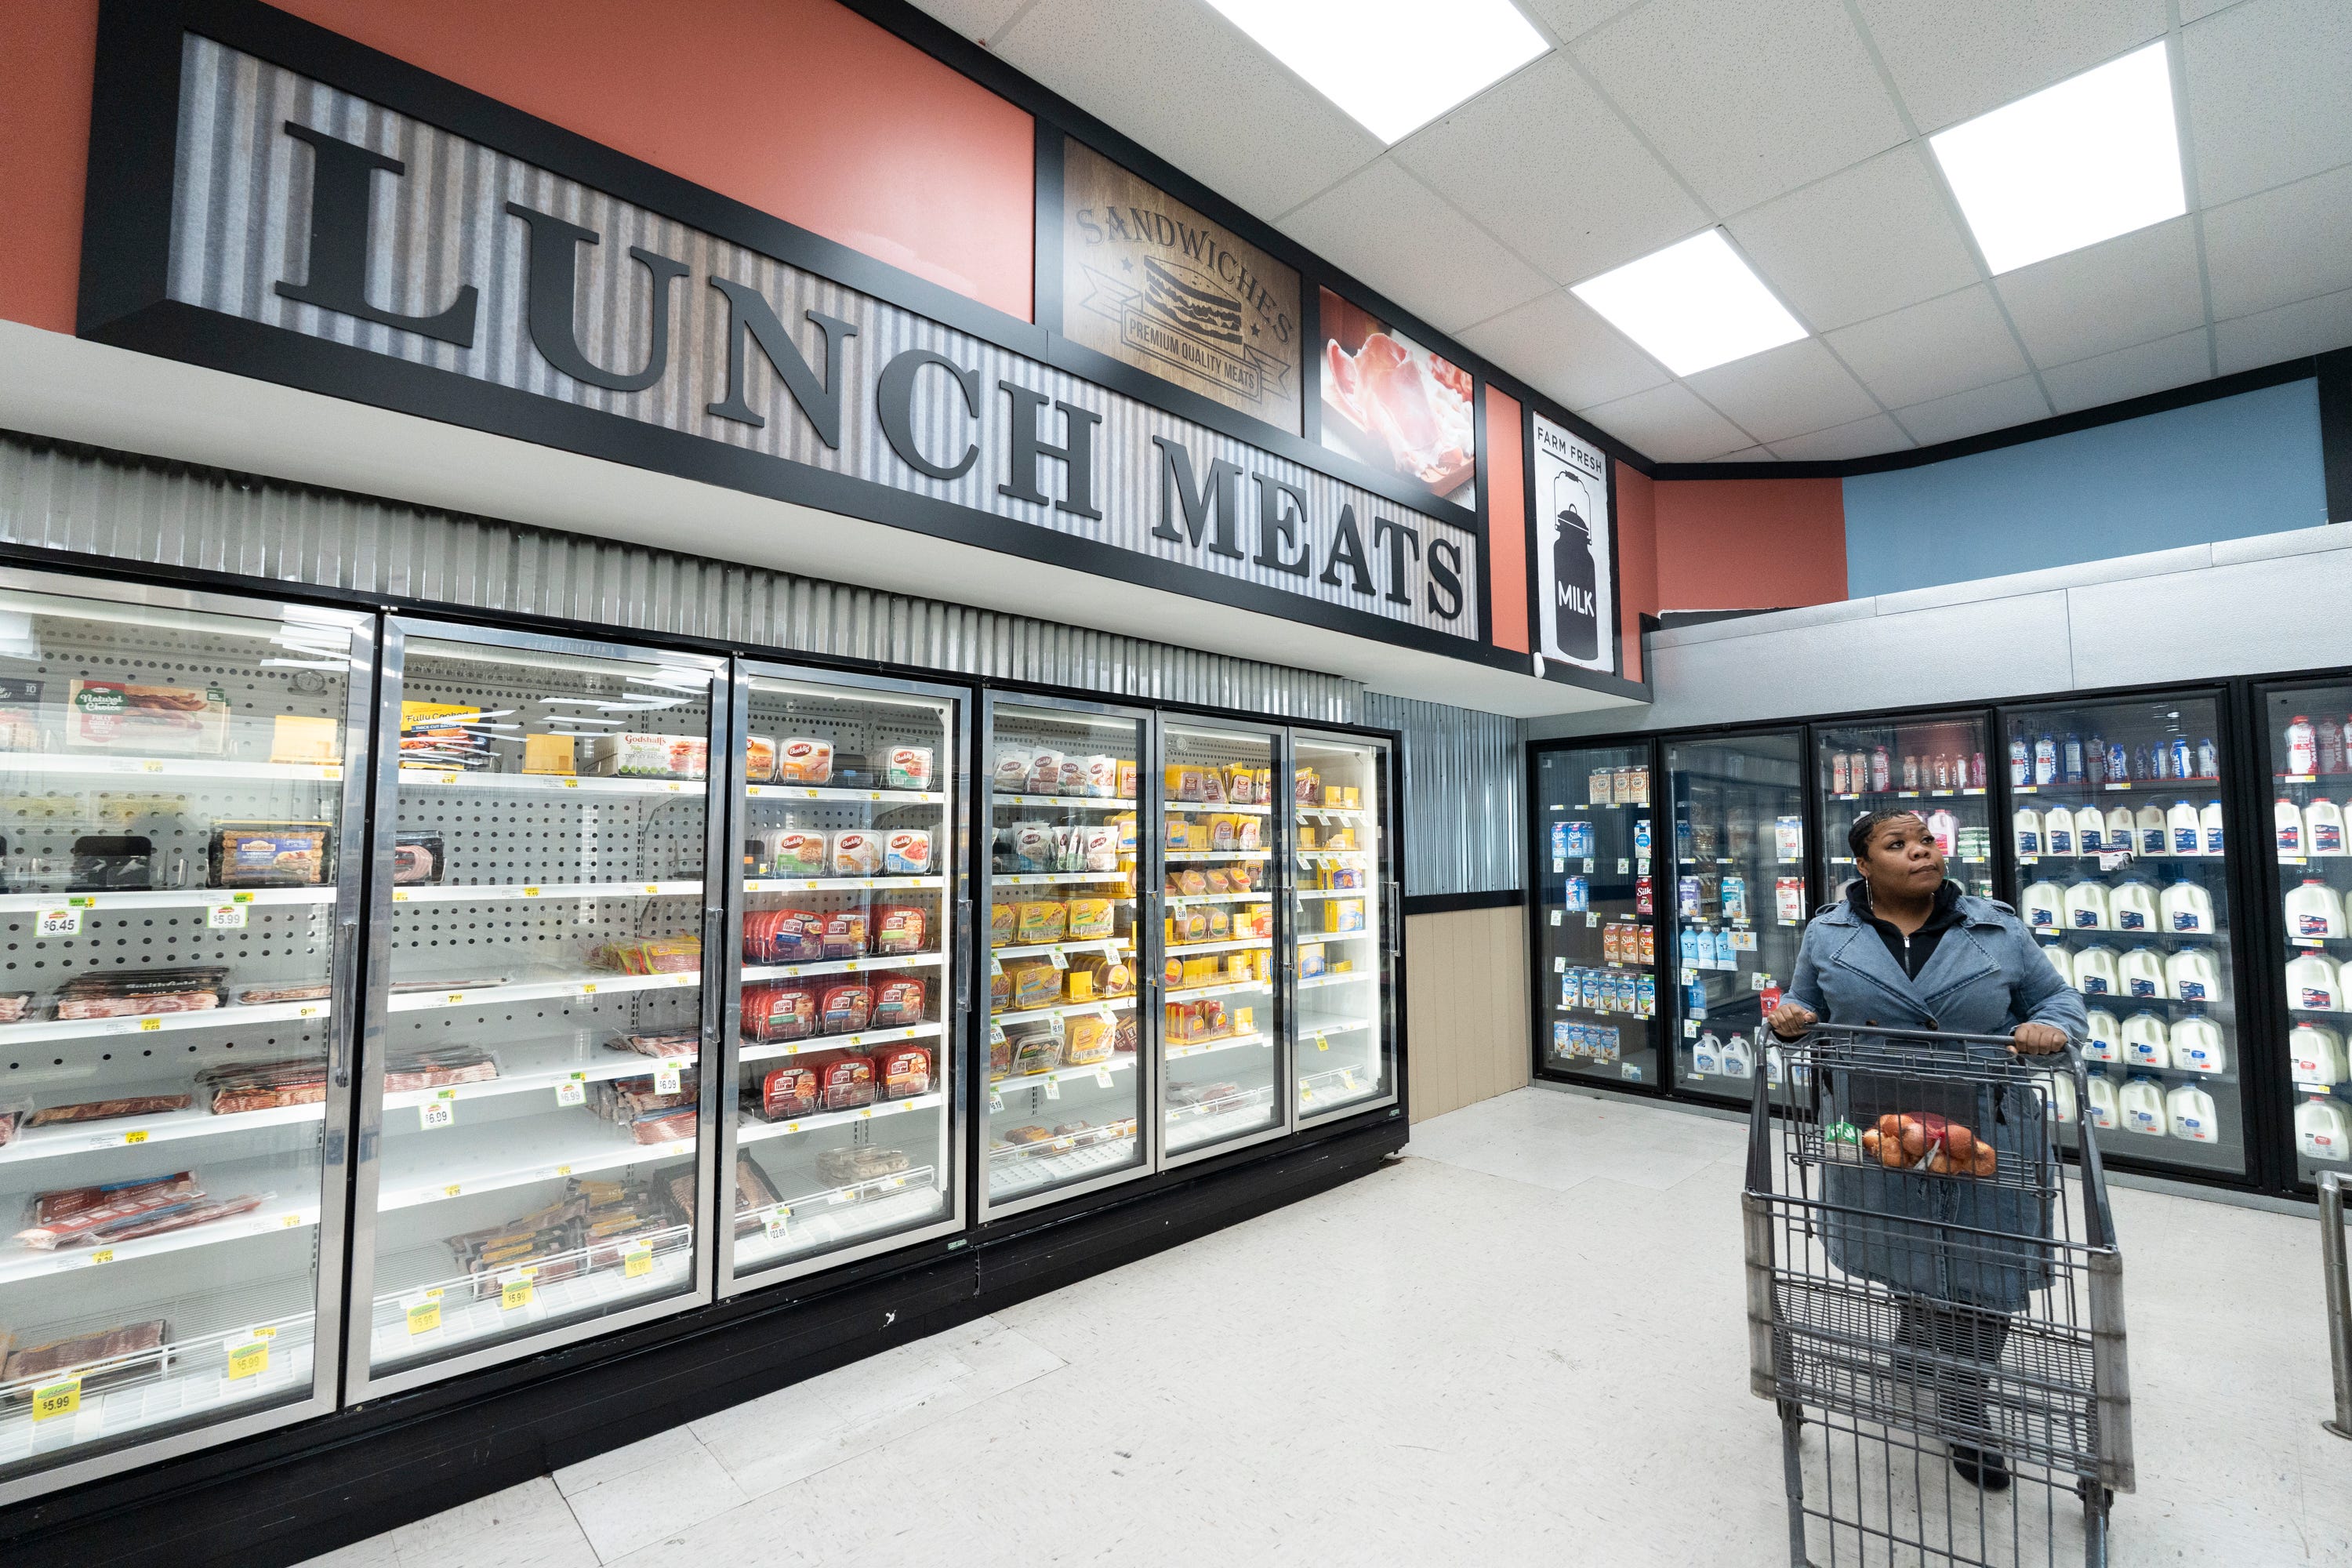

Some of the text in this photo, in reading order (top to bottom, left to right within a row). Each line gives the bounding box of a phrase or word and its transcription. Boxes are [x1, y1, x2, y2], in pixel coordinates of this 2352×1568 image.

[1076, 205, 1293, 346] SANDWICHES
[1129, 318, 1254, 390] PREMIUM QUALITY MEATS
[274, 120, 1465, 620] LUNCH MEATS
[1537, 426, 1602, 474] FARM FRESH
[1558, 579, 1595, 618] MILK
[80, 693, 123, 706] Natural
[85, 702, 122, 711] Choice
[789, 745, 811, 755] Buddig
[895, 751, 913, 761] Buddig
[1552, 831, 1566, 840] Silk
[1568, 831, 1582, 840] Silk
[784, 836, 804, 847] Buddig
[842, 836, 862, 847] Buddig
[893, 836, 913, 847] Buddig
[1636, 886, 1652, 896] Silk
[213, 914, 241, 924] $5.99
[43, 919, 75, 931] $6.45
[1605, 934, 1618, 943] Silk
[1621, 935, 1635, 945] Silk
[1639, 936, 1653, 946] Silk
[507, 1292, 526, 1305] $5.99
[238, 1356, 260, 1370] $5.99
[43, 1396, 70, 1411] $5.99
